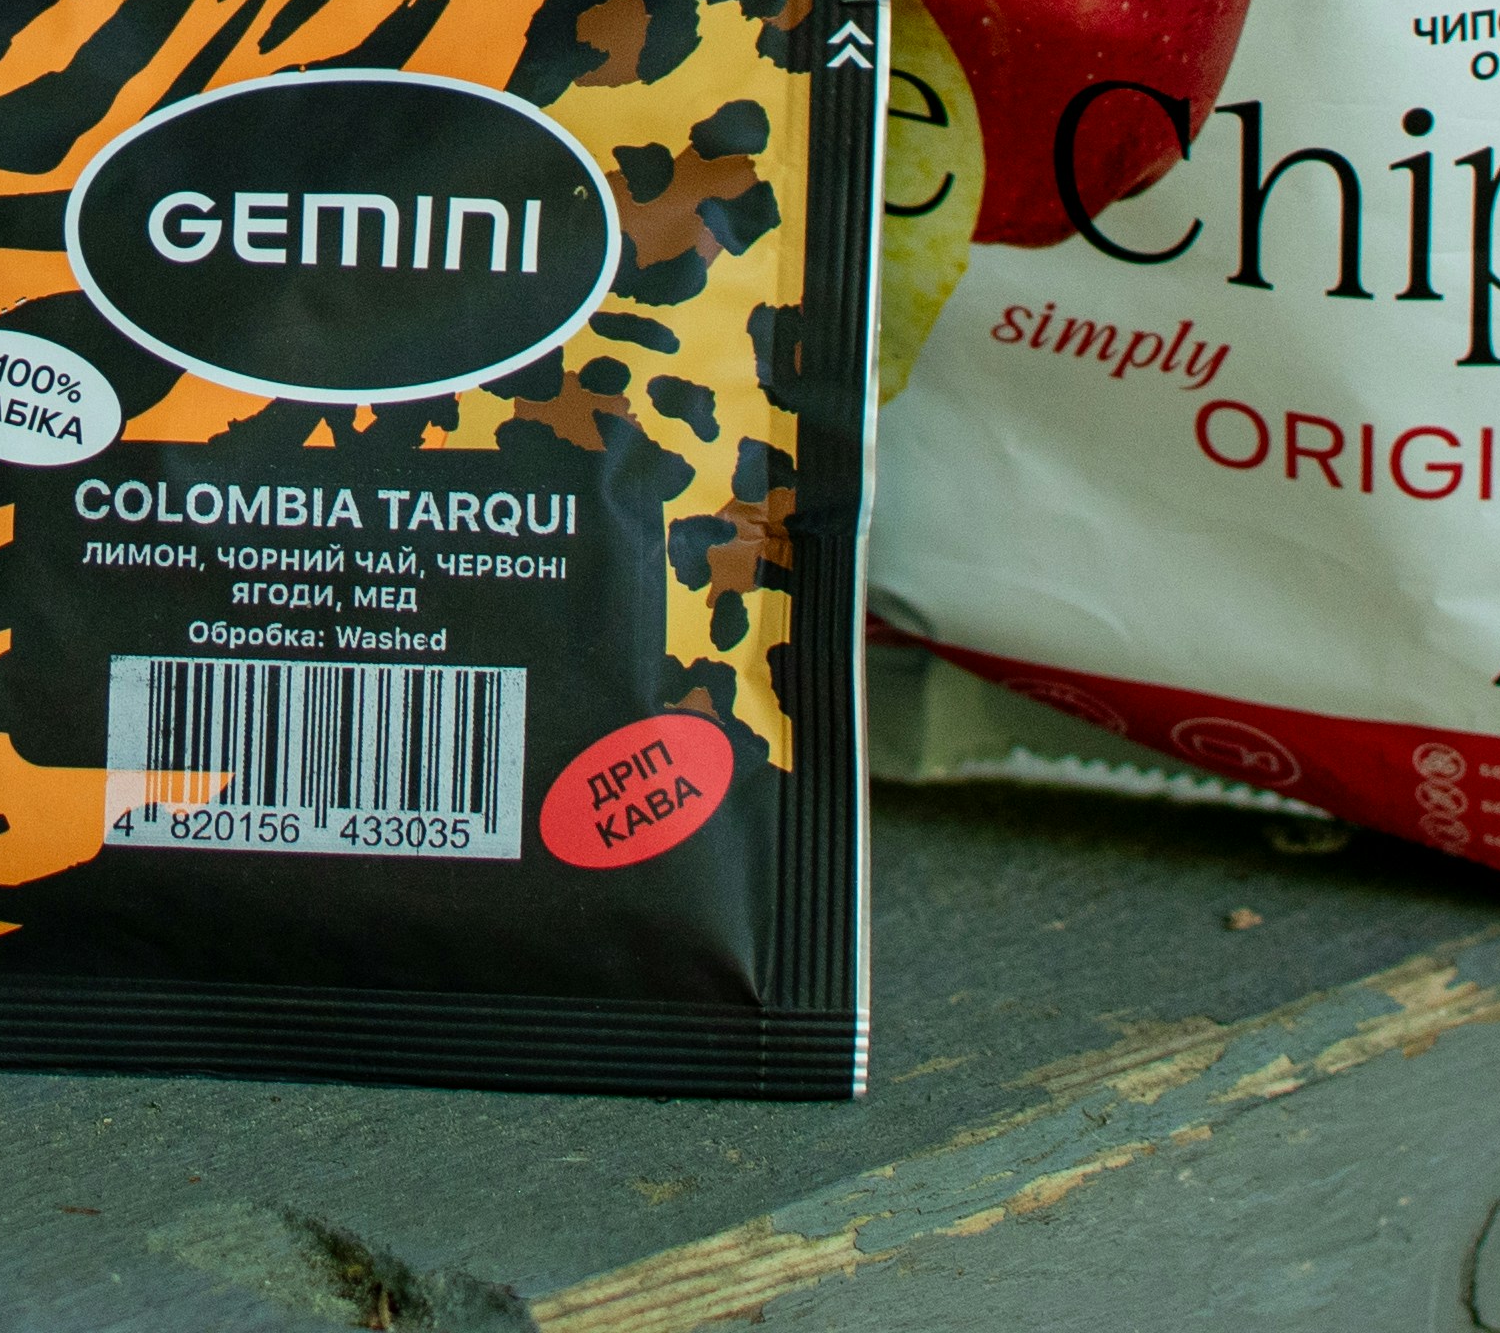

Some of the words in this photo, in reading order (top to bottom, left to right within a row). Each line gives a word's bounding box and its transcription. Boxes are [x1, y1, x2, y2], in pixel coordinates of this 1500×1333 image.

[147, 190, 542, 275] GEMINI
[990, 302, 1232, 392] simply
[74, 477, 364, 530] COLOMBIA
[377, 487, 577, 537] TARQUI
[81, 541, 206, 573] ЛИМОН,
[216, 542, 346, 574] ЧОРНИЙ
[354, 545, 426, 578] ЧАЙ,
[437, 552, 568, 581] ЧЕРВОНІ
[230, 580, 343, 613] ЯГОДИ,
[353, 585, 418, 613] МЕД
[187, 619, 326, 652] Обробка:
[335, 624, 447, 652] Washed
[585, 738, 675, 811] ДРІП
[112, 812, 134, 838] 4
[170, 812, 301, 844] 820156
[339, 814, 471, 849] 433035
[594, 774, 704, 851] КАВА
